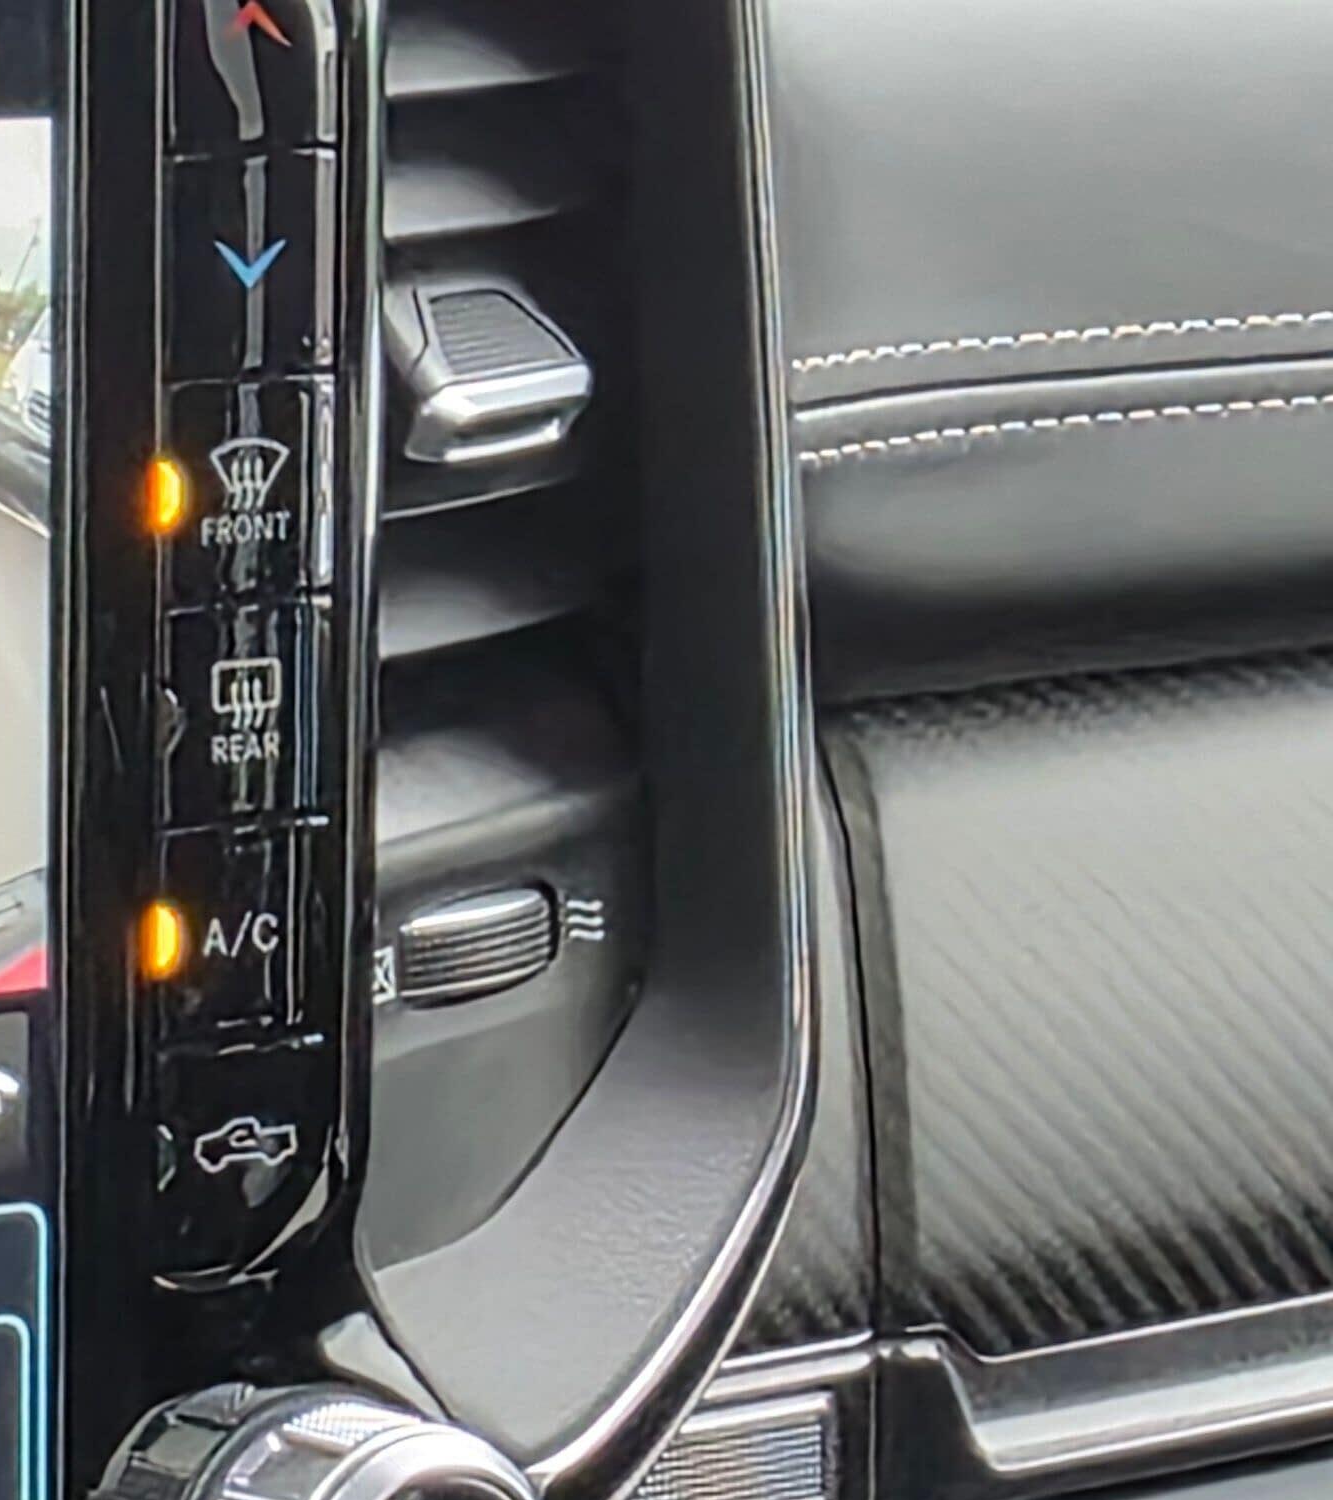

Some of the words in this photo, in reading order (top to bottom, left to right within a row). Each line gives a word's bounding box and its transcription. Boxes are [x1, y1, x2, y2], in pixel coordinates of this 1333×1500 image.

[200, 510, 291, 547] FRONT
[211, 730, 281, 765] REAR
[202, 910, 279, 958] A/C
